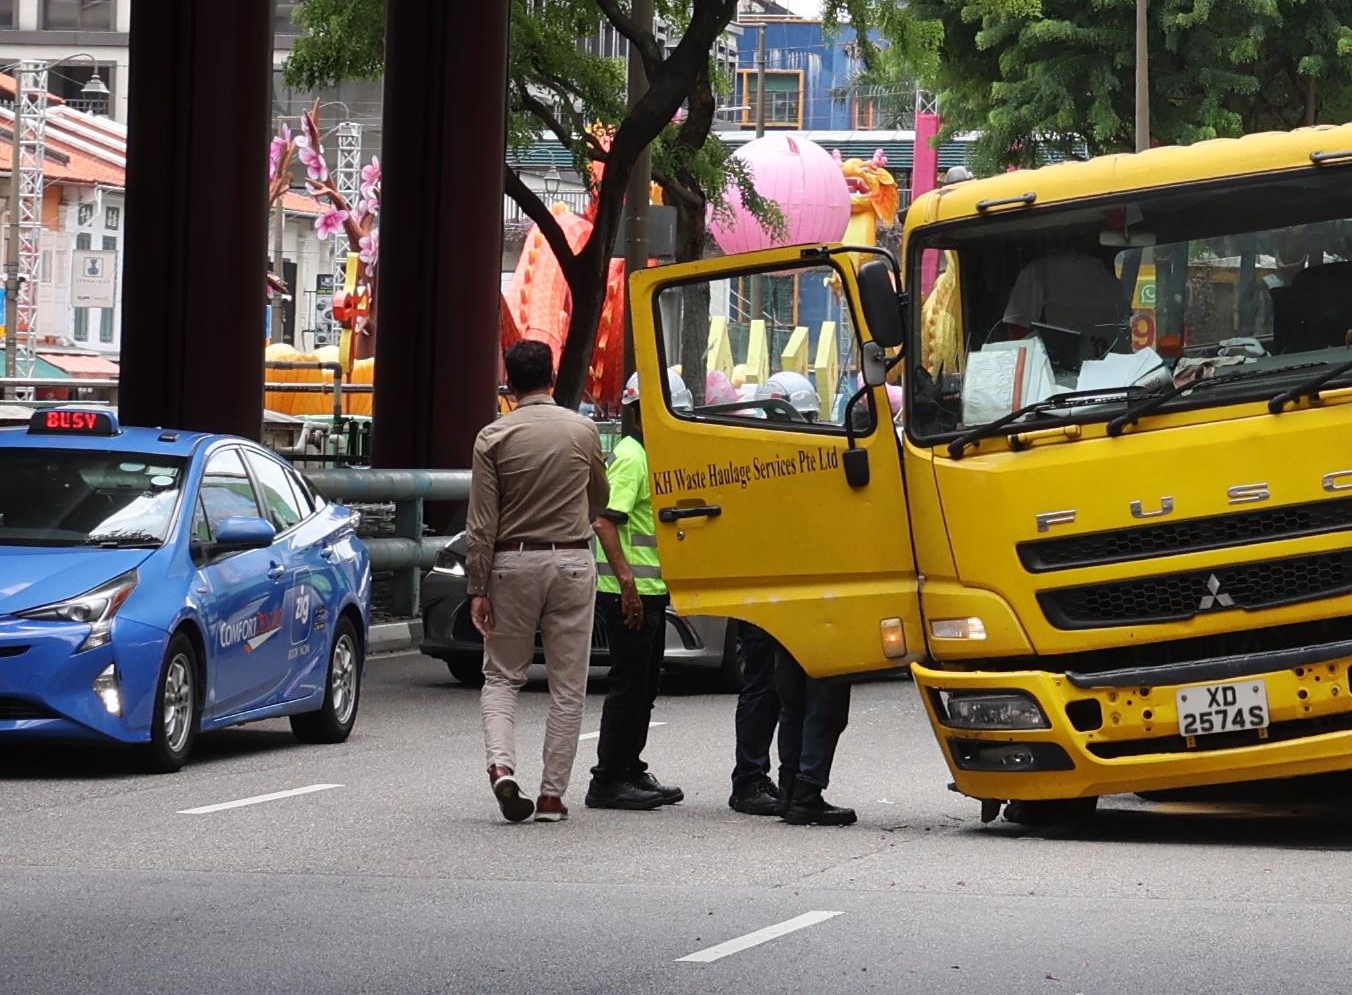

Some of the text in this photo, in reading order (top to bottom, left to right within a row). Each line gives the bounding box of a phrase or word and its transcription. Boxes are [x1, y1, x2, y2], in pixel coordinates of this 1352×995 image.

[1131, 314, 1155, 350] 9
[46, 411, 97, 430] BUSY
[653, 446, 839, 496] KH Waste Haulage Services Pte Ltd
[1206, 686, 1237, 708] XD
[1183, 705, 1265, 735] 2574S
